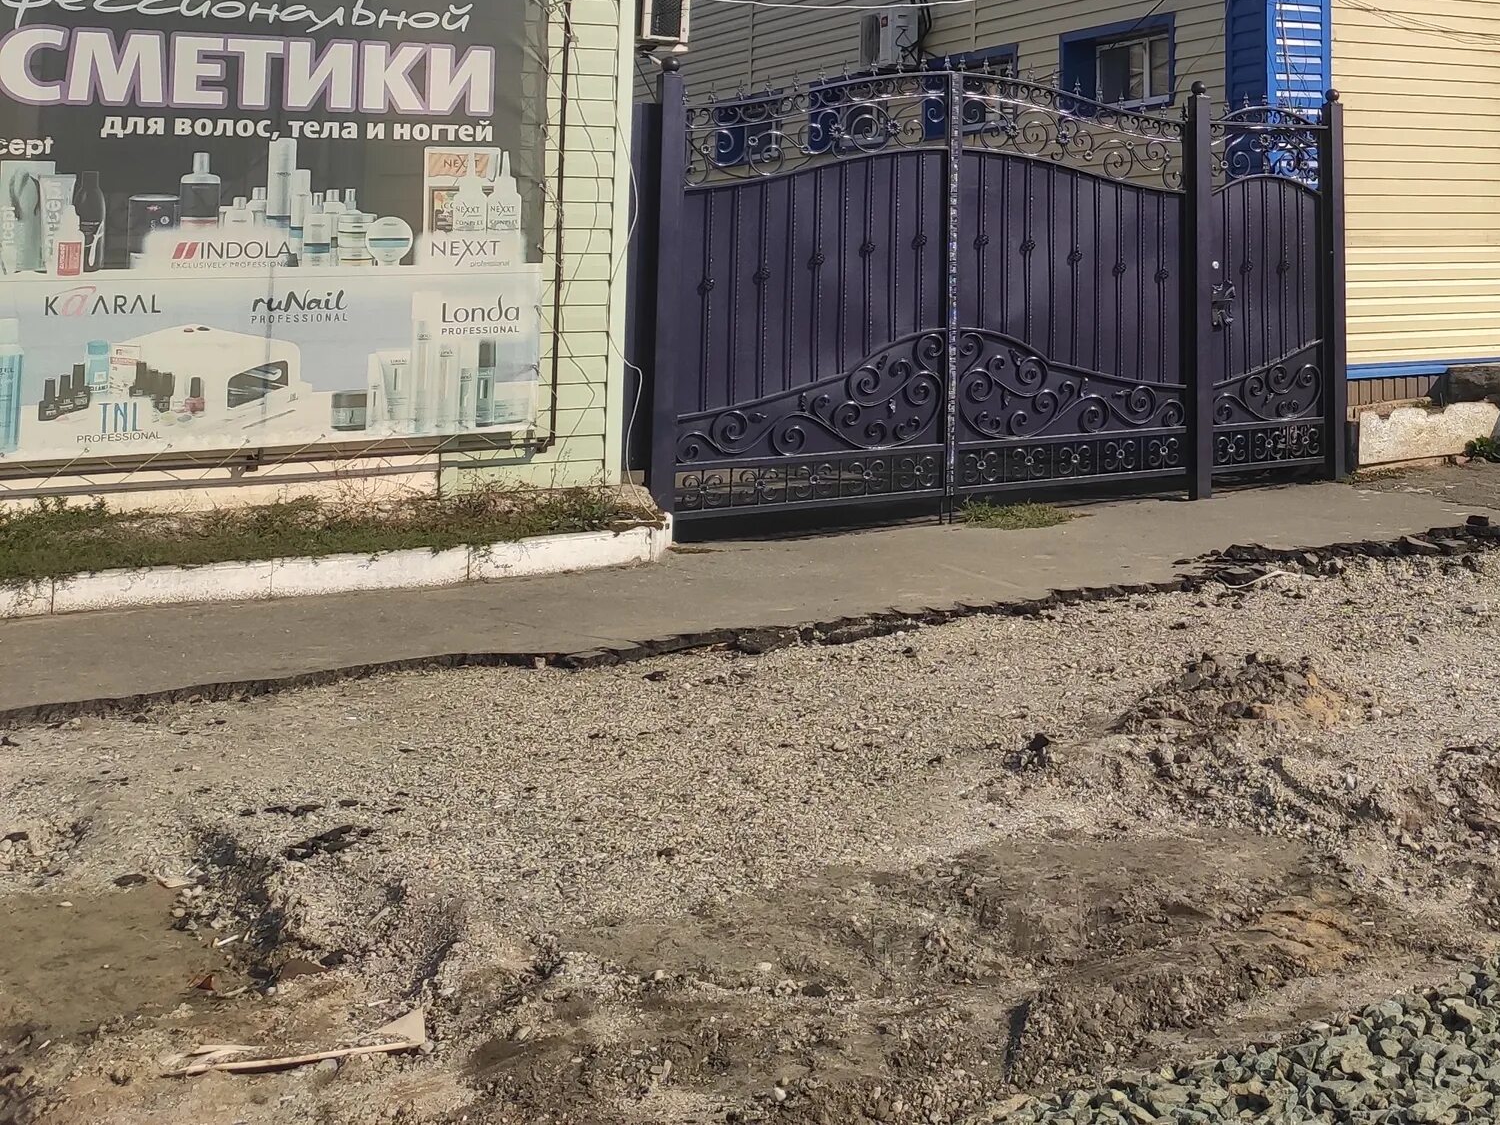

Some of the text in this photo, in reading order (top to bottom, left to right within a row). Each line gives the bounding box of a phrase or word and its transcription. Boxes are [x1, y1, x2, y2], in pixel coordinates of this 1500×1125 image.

[0, 25, 494, 115] СМЕТИКИ
[100, 116, 494, 143] для волос, тела и ногтей
[200, 241, 290, 259] INDOLA
[431, 239, 501, 267] NEXXT
[251, 289, 348, 312] ruNail
[441, 293, 520, 323] Londa
[251, 313, 349, 324] PROFESSIONAL
[441, 325, 520, 336] PROFESSIONAL
[98, 402, 143, 433] TNL
[77, 432, 163, 443] PROFESSIONAL
